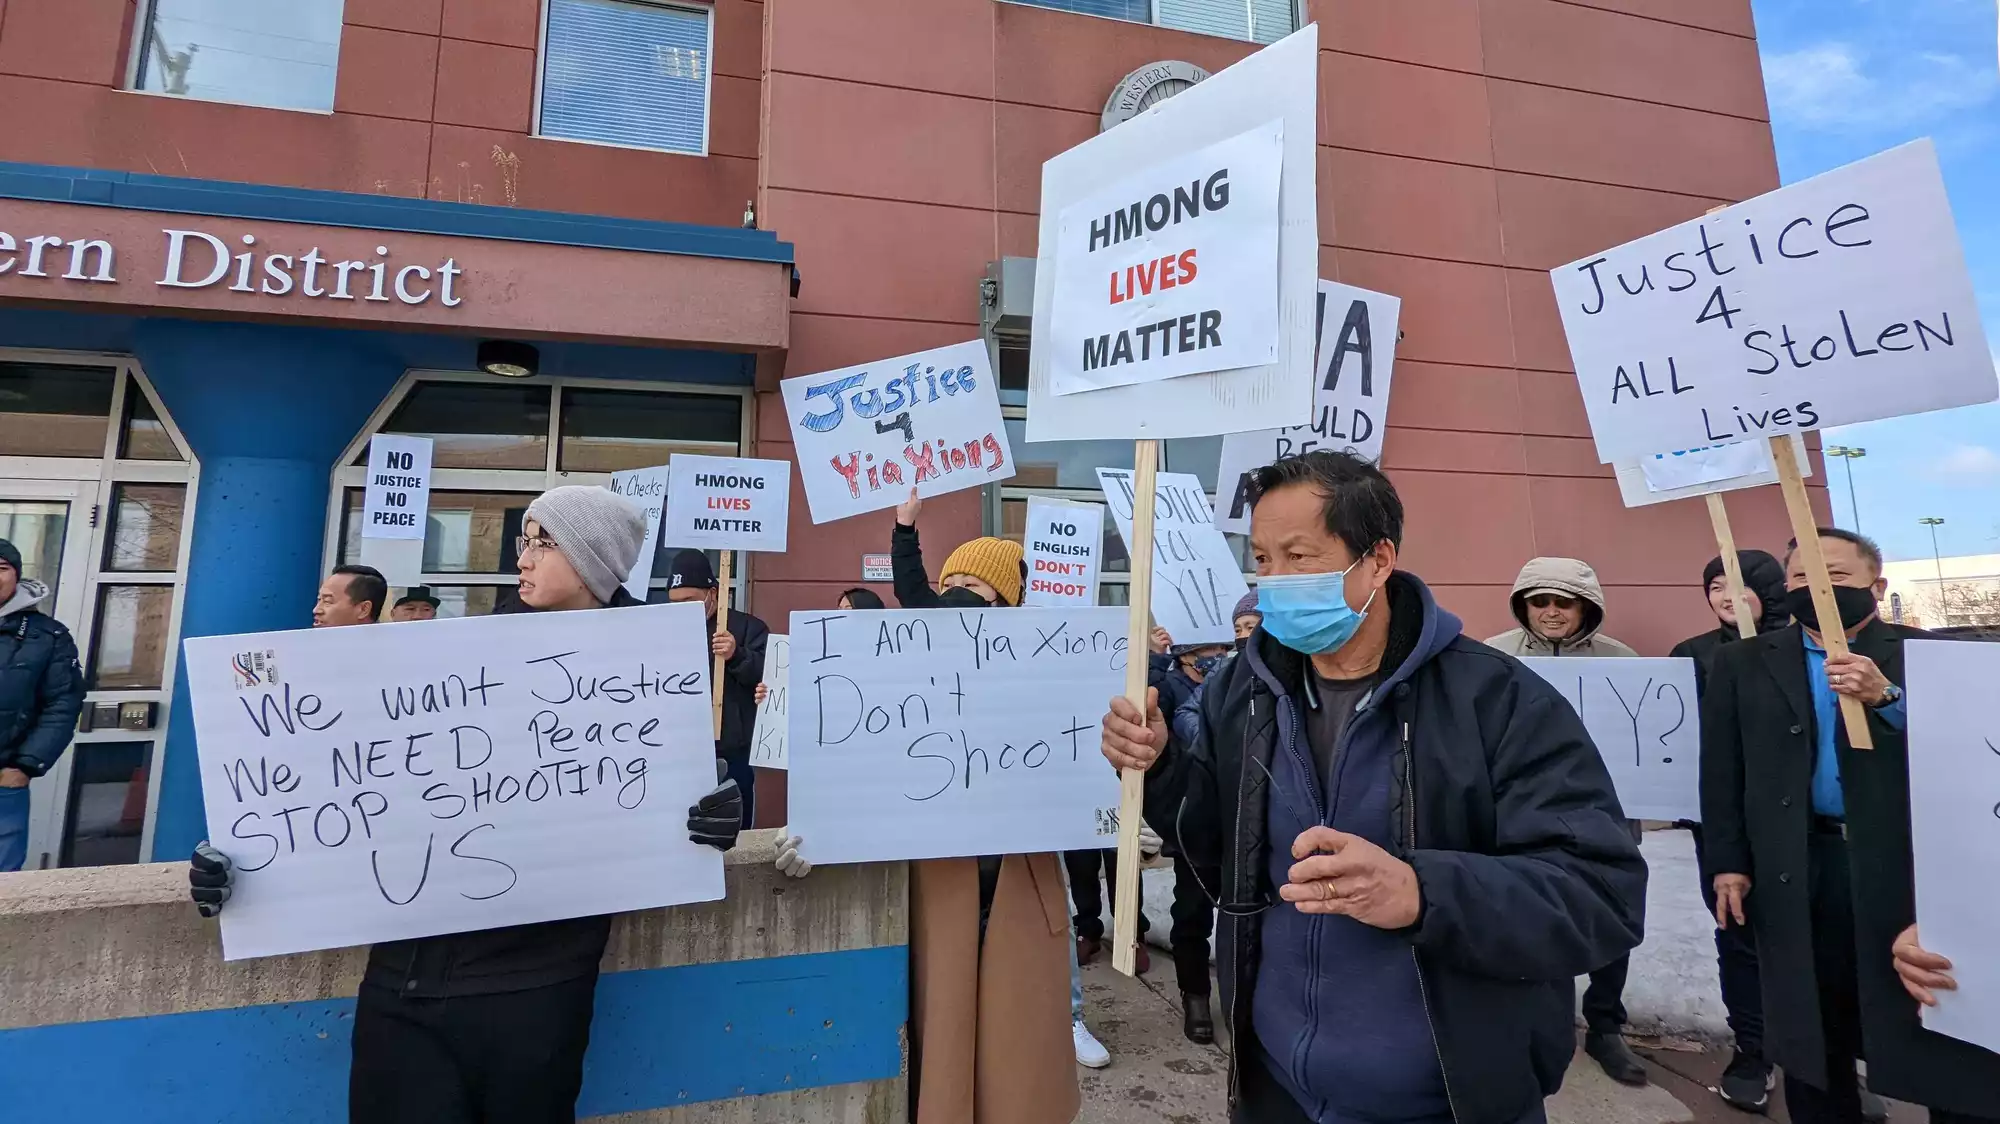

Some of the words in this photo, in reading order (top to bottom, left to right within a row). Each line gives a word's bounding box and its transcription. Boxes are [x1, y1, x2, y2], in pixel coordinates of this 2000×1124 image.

[1120, 65, 1173, 112] WESTERN
[1088, 168, 1230, 253] HMONG
[155, 228, 464, 307] District
[1109, 248, 1198, 305] LIVES
[1577, 203, 1872, 314] Justice
[1695, 285, 1741, 328] 4
[1082, 308, 1223, 372] MATTER
[799, 361, 978, 433] Justice
[1612, 356, 1695, 404] ALL
[874, 411, 915, 443] 4
[1701, 400, 1820, 440] Lives
[373, 474, 422, 488] JUSTICE
[386, 451, 414, 471] NO
[695, 473, 765, 490] HMONG
[830, 449, 904, 499] Yia
[903, 431, 1005, 485] Xiong
[385, 491, 407, 507] NO
[626, 474, 662, 497] Checks
[707, 496, 751, 511] LIVES
[372, 511, 416, 527] PEACE
[693, 517, 762, 533] MATTER
[1049, 521, 1077, 537] NO
[870, 557, 892, 566] NOTICE
[1033, 541, 1090, 557] ENGLISH
[1034, 559, 1087, 576] DON'T
[1030, 579, 1087, 597] SHOOT
[803, 615, 848, 663] I
[959, 612, 1017, 669] Yia
[1031, 621, 1129, 670] Xiong
[239, 682, 342, 737] We
[381, 665, 504, 721] want
[525, 650, 705, 704] Justice
[813, 672, 966, 747] Don't
[222, 756, 301, 802] We
[331, 724, 493, 788] NEED
[528, 709, 664, 757] Peace
[903, 715, 1096, 800] Shoot
[230, 791, 389, 872] STOP
[371, 823, 517, 905] US
